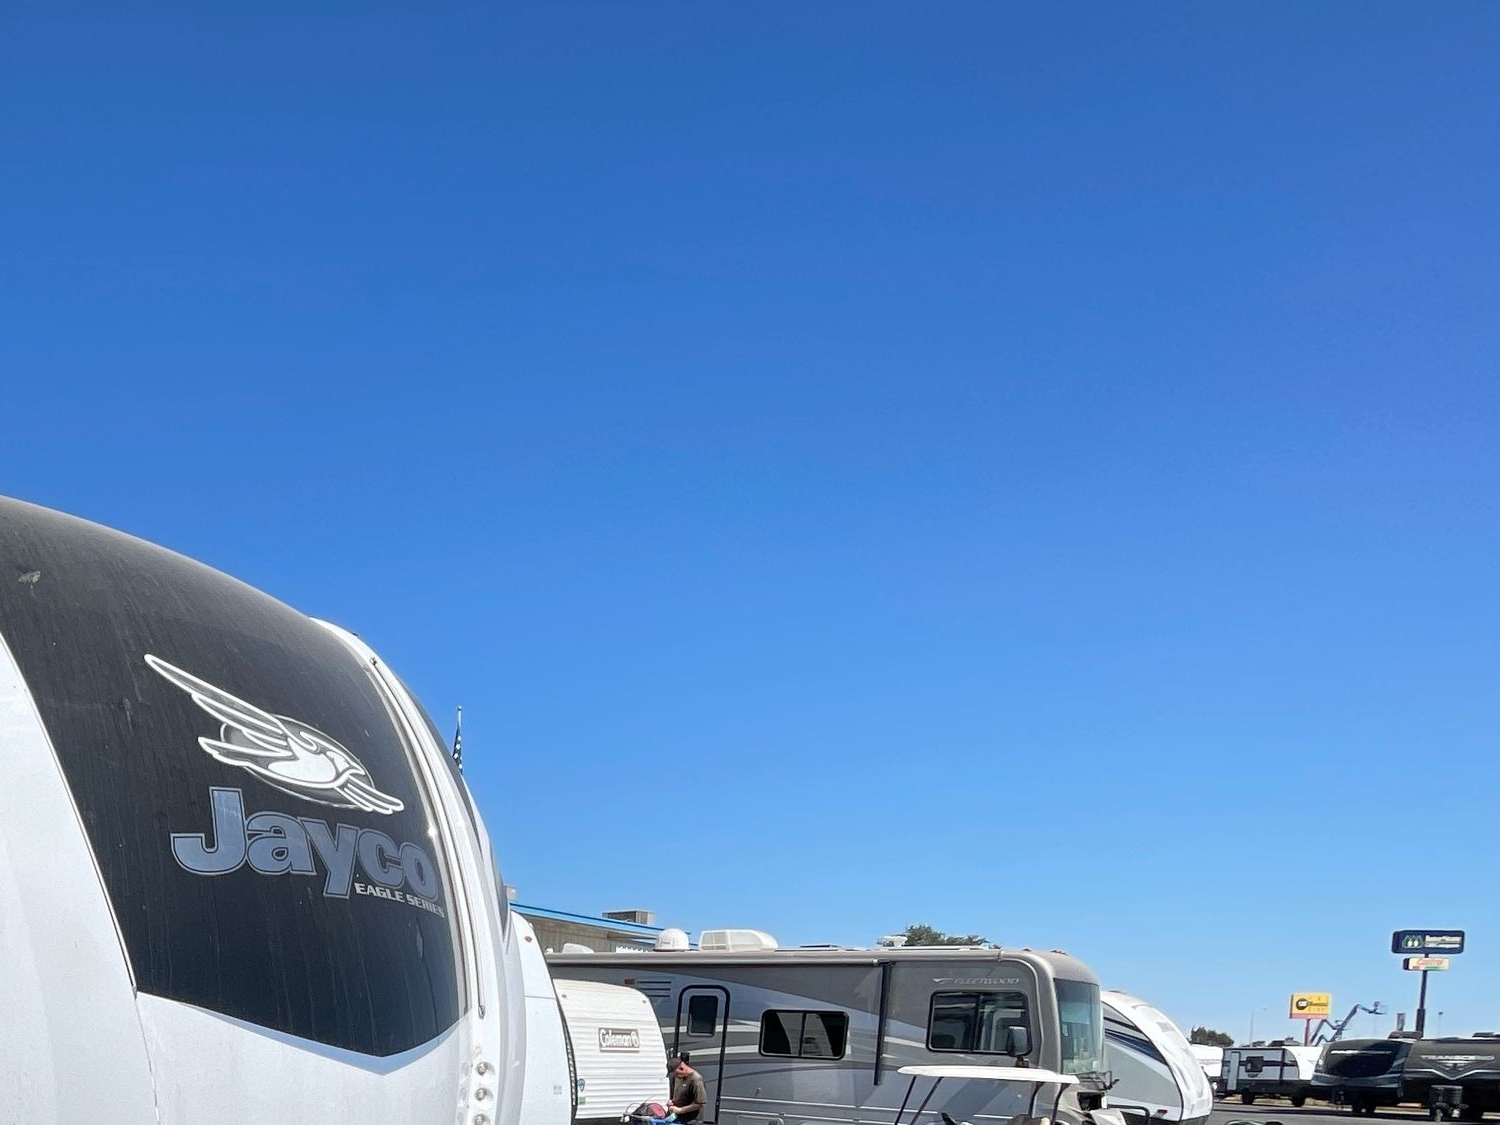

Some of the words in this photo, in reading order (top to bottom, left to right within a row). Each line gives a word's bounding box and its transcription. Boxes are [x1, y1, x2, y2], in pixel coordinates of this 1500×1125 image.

[170, 786, 438, 902] Jayco
[354, 882, 404, 902] EAGLE
[406, 894, 445, 918] SERIES
[600, 1029, 632, 1047] Coleman
